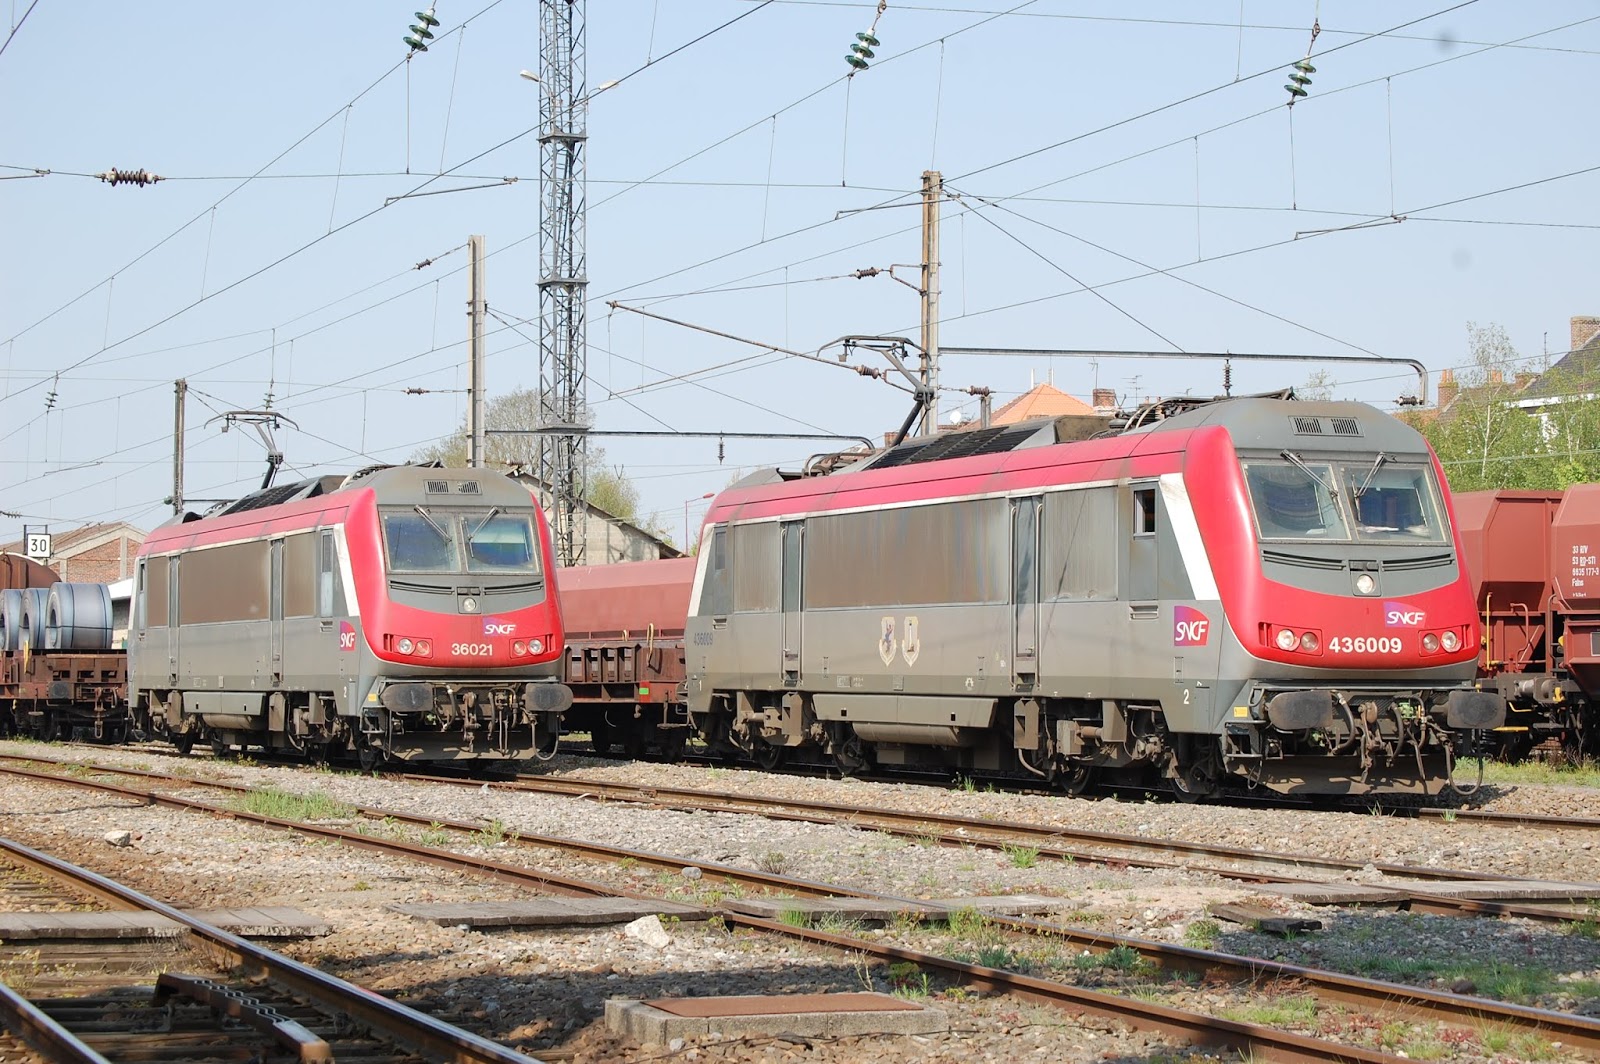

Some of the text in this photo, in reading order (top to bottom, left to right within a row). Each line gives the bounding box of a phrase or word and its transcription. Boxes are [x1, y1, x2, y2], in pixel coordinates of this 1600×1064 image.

[31, 538, 47, 552] 30
[1387, 611, 1425, 625] SNCF
[484, 624, 516, 634] SNCF
[1175, 621, 1208, 642] SNCF
[340, 632, 356, 648] SNCF
[1328, 637, 1402, 653] 436009
[451, 643, 493, 656] 36021
[1183, 689, 1190, 704] 2
